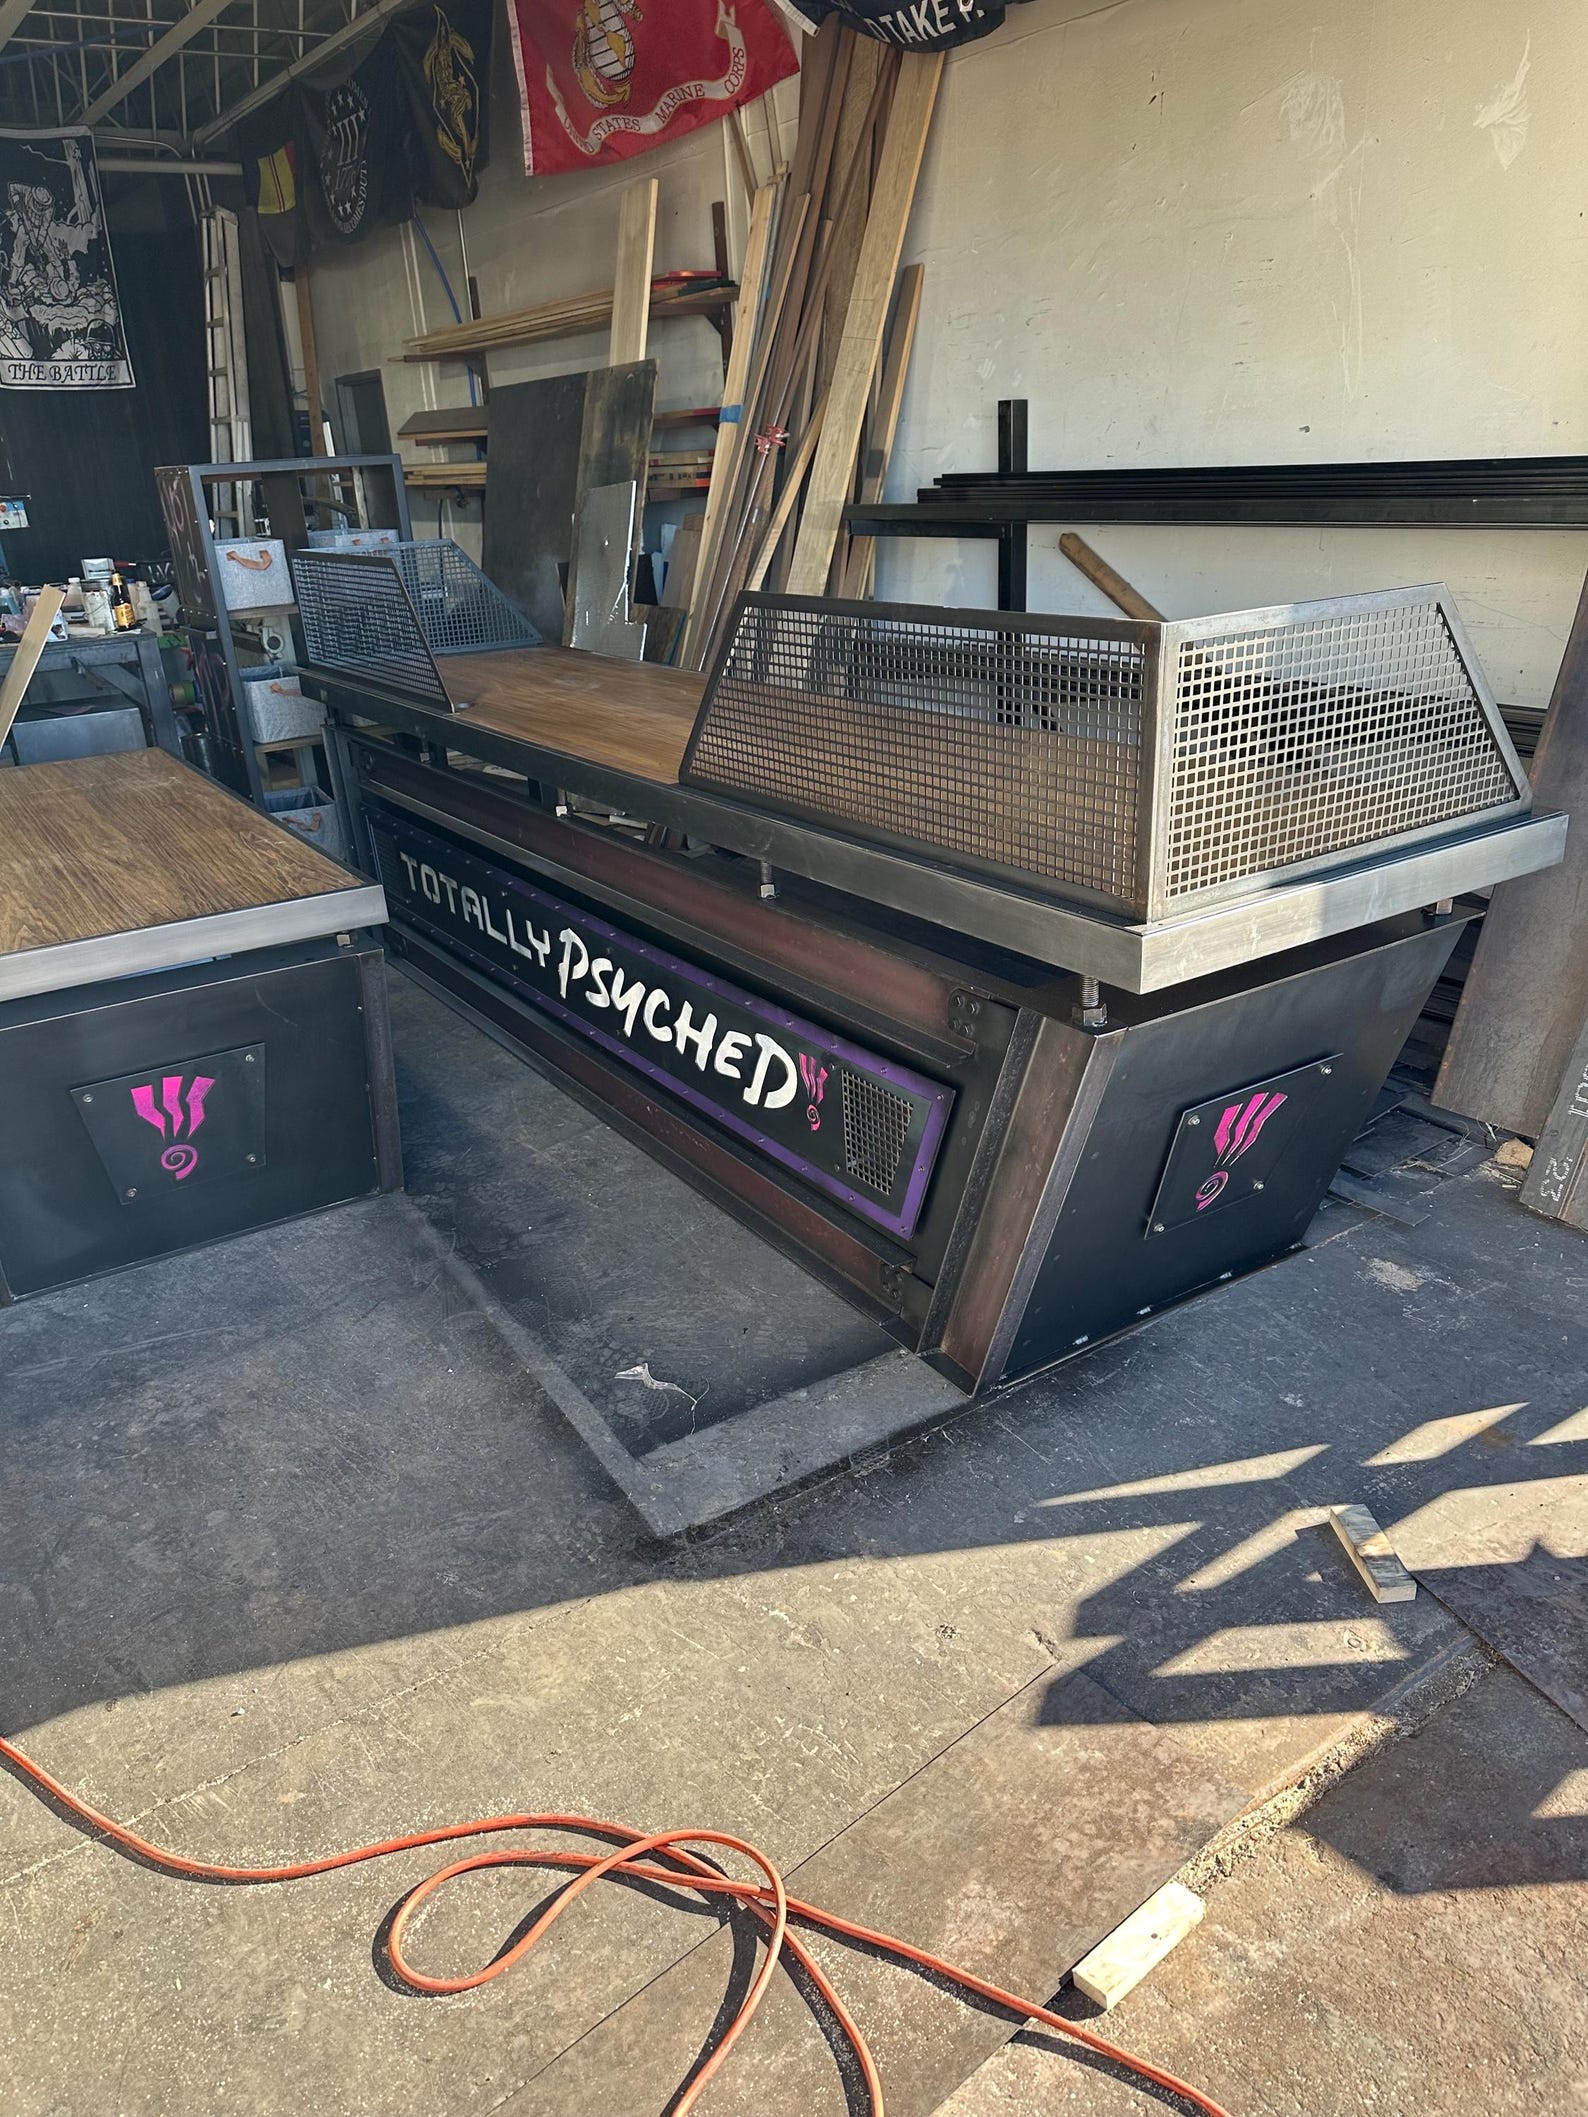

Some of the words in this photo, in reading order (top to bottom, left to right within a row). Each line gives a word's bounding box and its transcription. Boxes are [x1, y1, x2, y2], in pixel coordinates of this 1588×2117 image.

[879, 0, 956, 44] TAKE
[592, 117, 641, 141] STATES
[655, 83, 705, 124] MARINE
[723, 47, 745, 95] CORPS
[8, 363, 46, 380] THE
[49, 363, 117, 383] BATTLE
[400, 851, 551, 968] TOTALLY
[558, 927, 798, 1109] PSYCHED
